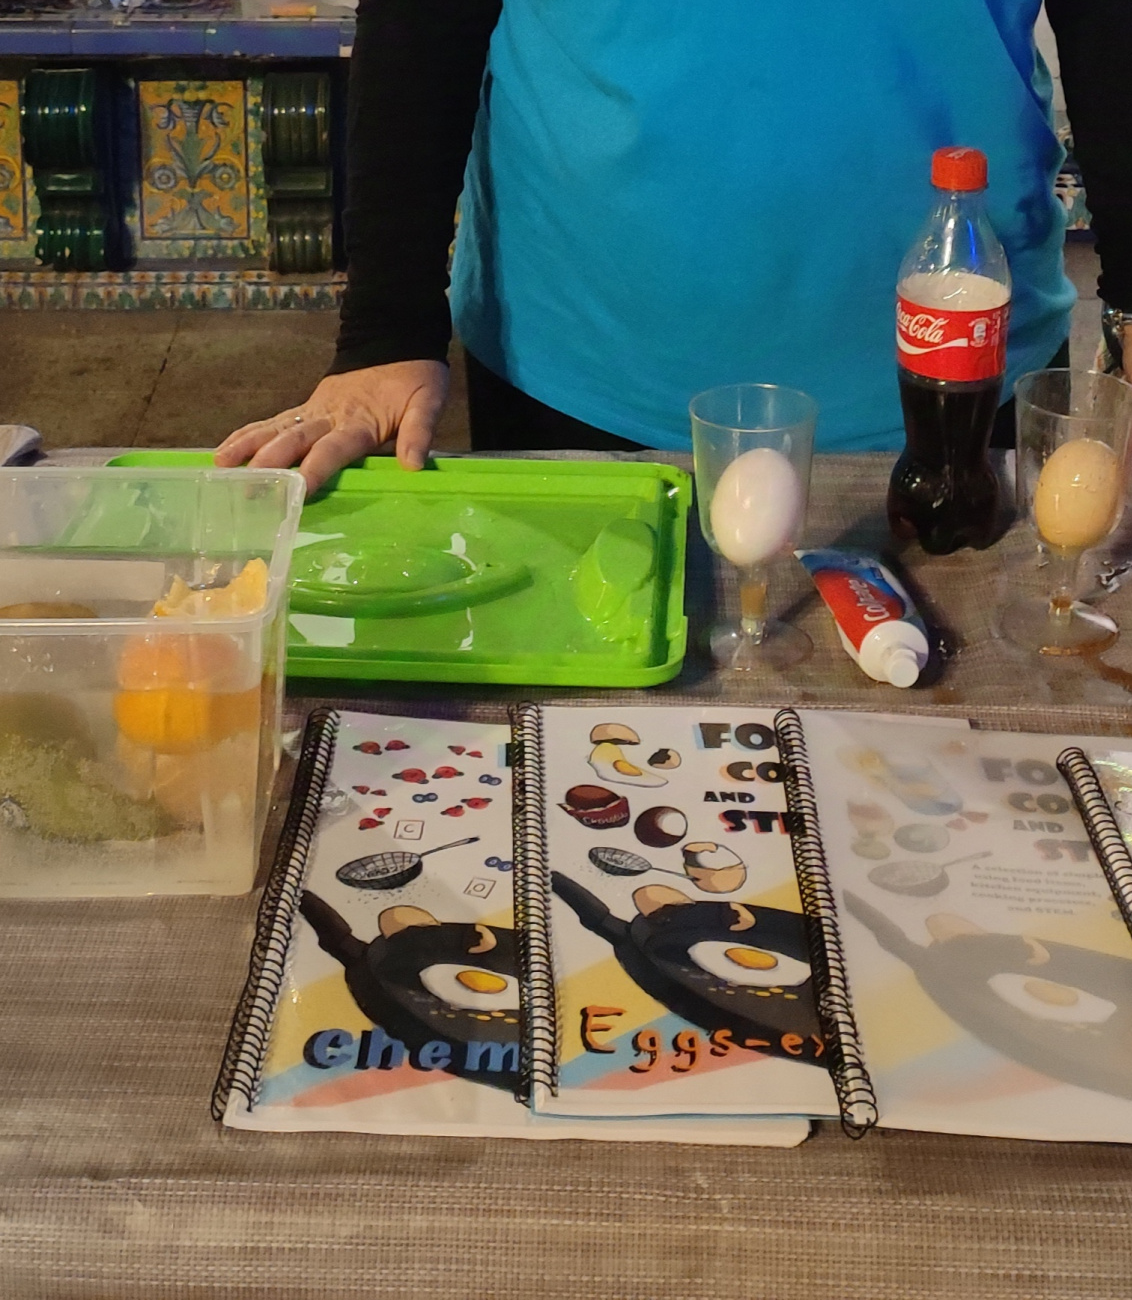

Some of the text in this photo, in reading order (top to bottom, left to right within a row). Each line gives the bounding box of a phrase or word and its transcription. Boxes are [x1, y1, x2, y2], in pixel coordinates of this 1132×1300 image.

[693, 722, 776, 750] FO
[719, 761, 789, 783] CO
[980, 757, 1060, 786] FO
[703, 791, 756, 803] AND
[1006, 792, 1071, 815] CO
[1013, 819, 1064, 833] AND
[1034, 838, 1092, 863] ST
[303, 1026, 520, 1071] Chem
